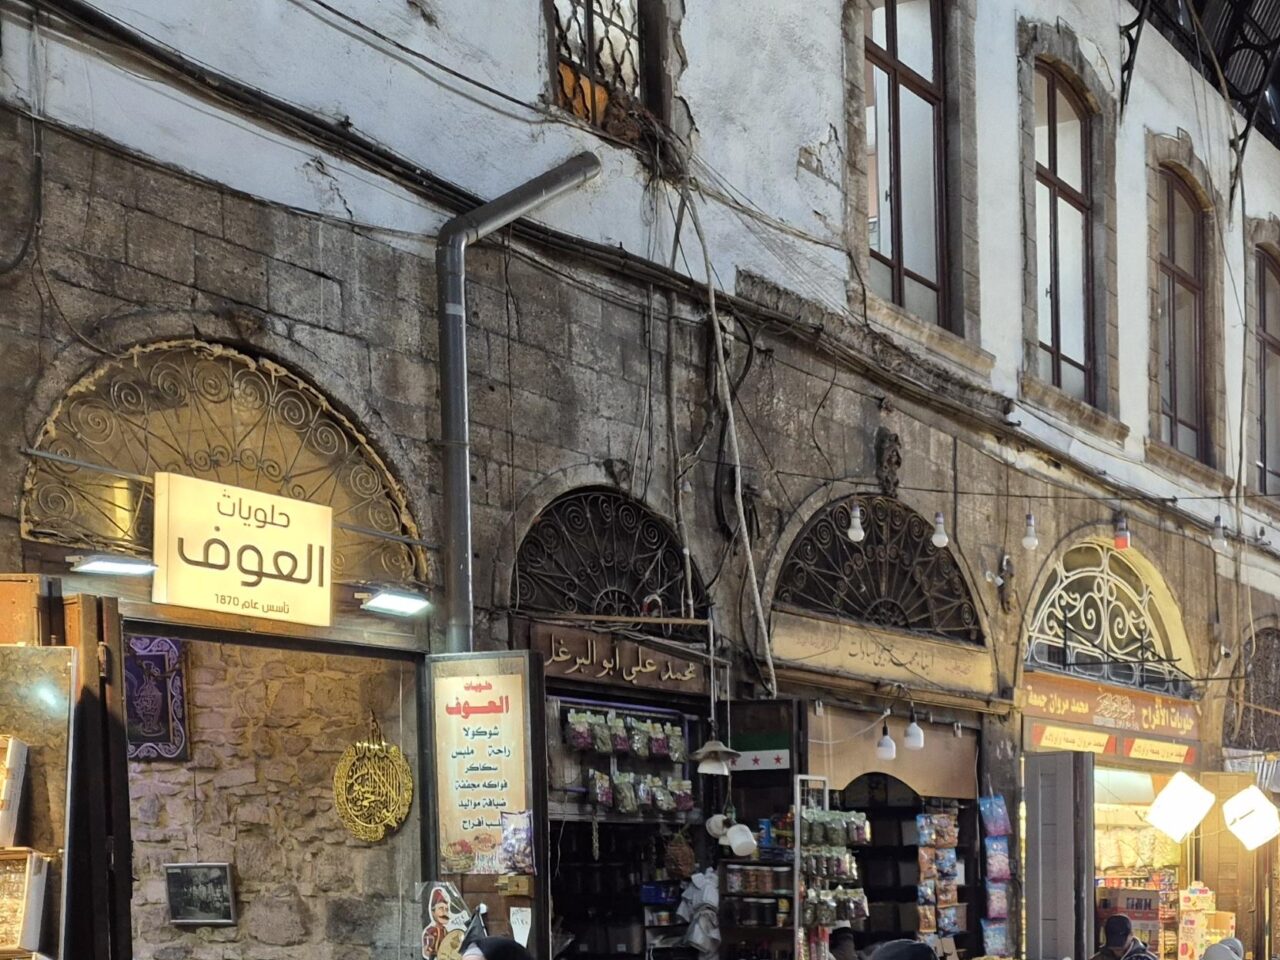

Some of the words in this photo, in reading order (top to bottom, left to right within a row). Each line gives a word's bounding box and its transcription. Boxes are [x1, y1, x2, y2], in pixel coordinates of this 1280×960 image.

[177, 525, 324, 587] العوف
[214, 593, 240, 606] 1870
[241, 599, 259, 609] عام
[622, 644, 657, 685] علي
[661, 661, 697, 681] محمد
[464, 680, 493, 694] حلويات
[445, 694, 510, 720] العوف
[462, 726, 500, 740] شوكولا
[487, 745, 511, 758] راحة
[464, 763, 498, 774] سكاكر
[462, 815, 484, 830] أفراح
[485, 818, 504, 830] لب
